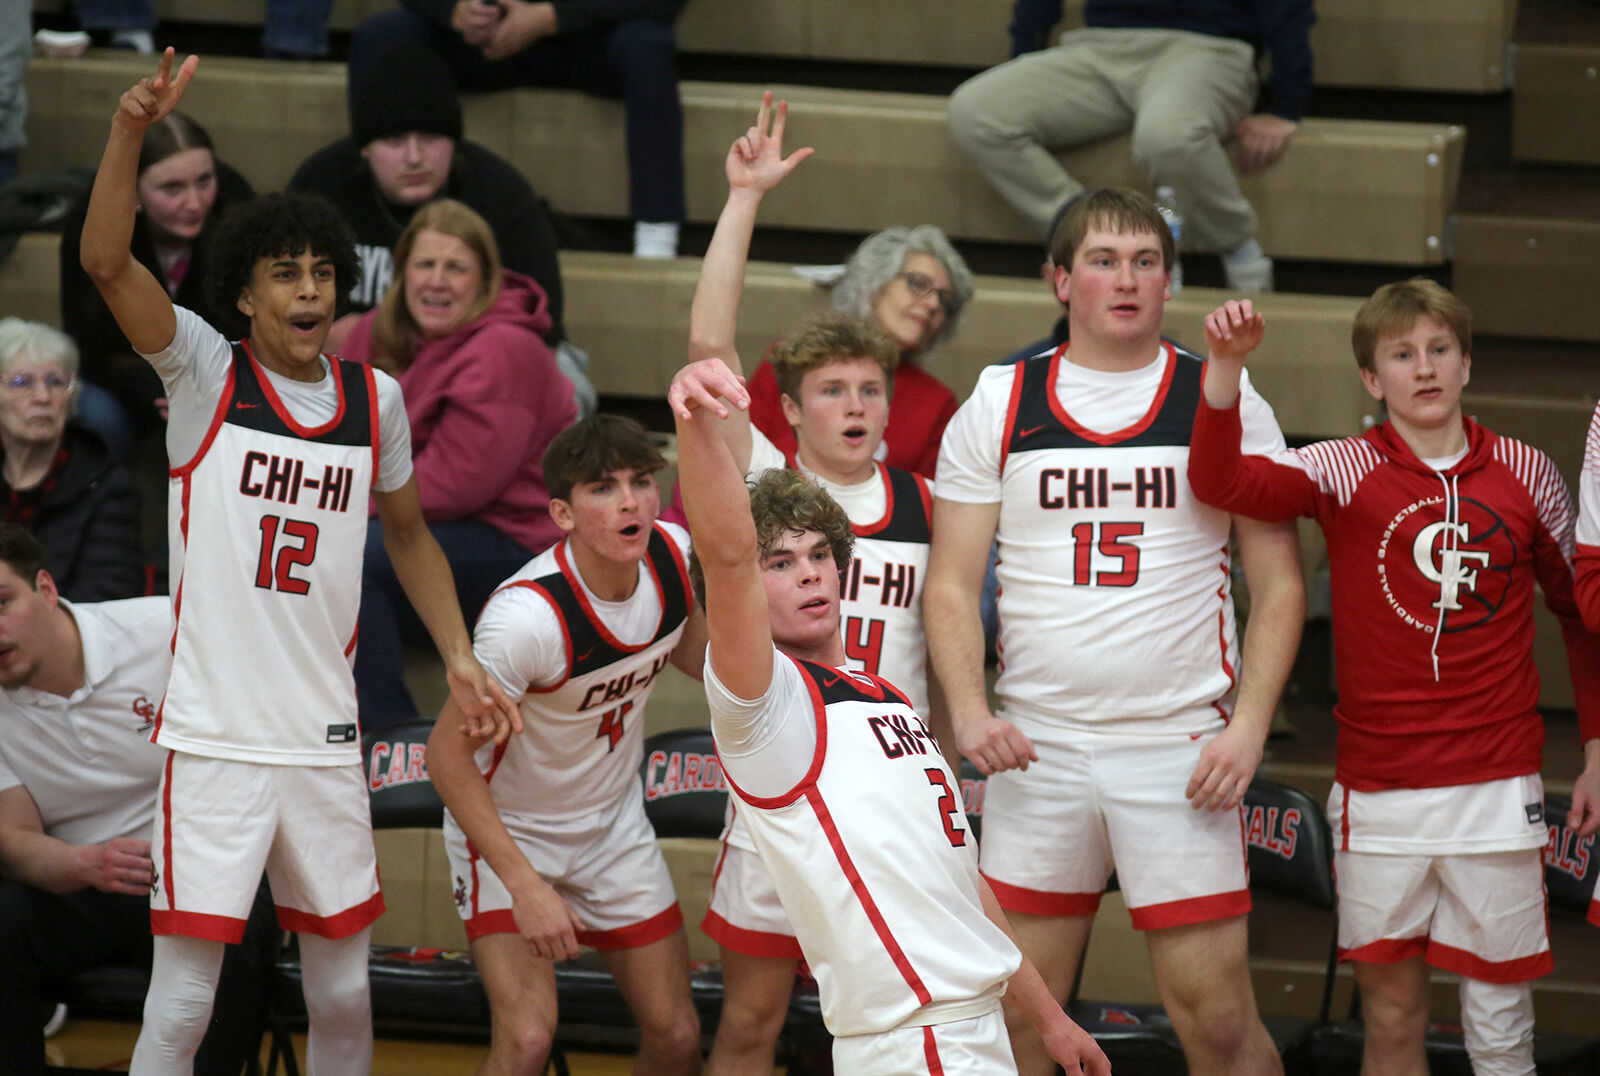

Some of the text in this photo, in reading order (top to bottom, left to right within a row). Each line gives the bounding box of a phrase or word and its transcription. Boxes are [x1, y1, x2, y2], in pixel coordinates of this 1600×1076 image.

[240, 450, 353, 512] CHI-HI
[1040, 467, 1176, 509] CHI-HI
[254, 514, 319, 595] 12
[1071, 521, 1144, 587] 15
[1377, 495, 1444, 559] BASKETBALL
[839, 557, 915, 608] I-HI
[1377, 563, 1434, 634] CARDINALS
[839, 613, 885, 675] 4
[596, 700, 633, 754] 4
[369, 741, 432, 792] CAR
[924, 768, 967, 847] 2
[1243, 806, 1301, 860] ALS
[1545, 826, 1595, 880] ALS
